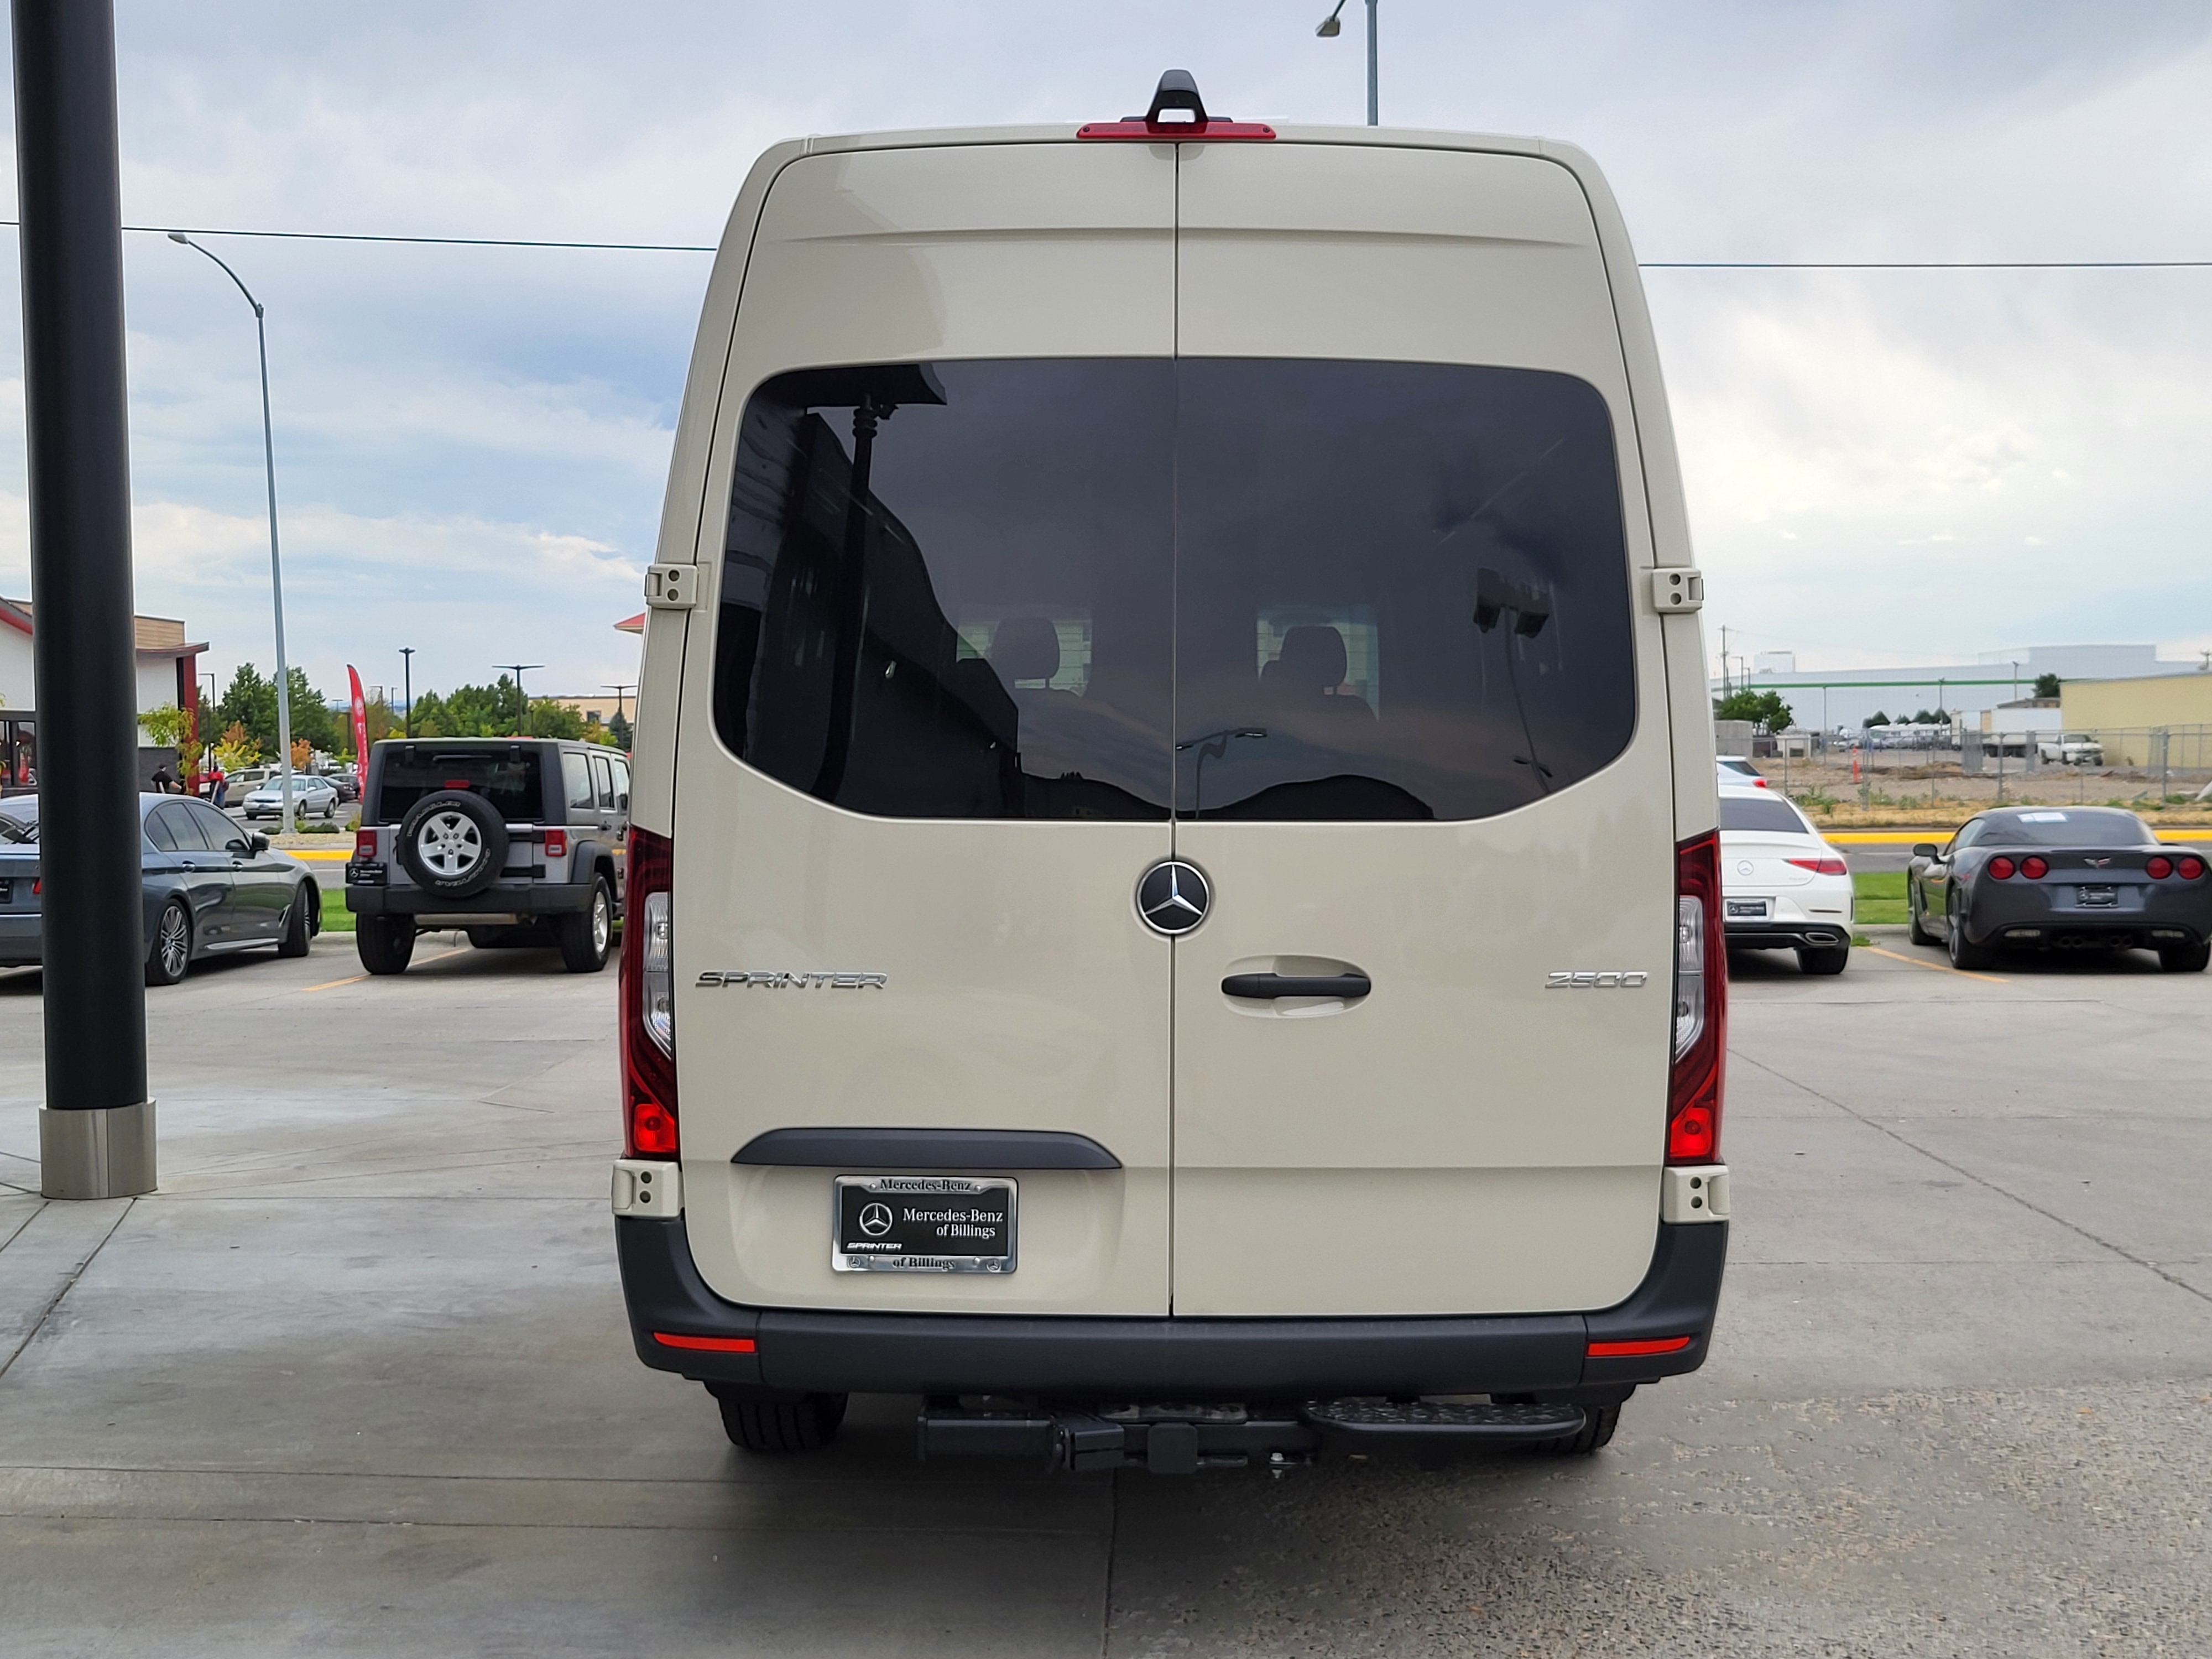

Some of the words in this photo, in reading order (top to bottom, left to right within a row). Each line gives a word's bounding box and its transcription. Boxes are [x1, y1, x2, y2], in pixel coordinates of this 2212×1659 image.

[695, 971, 888, 988] SPRINTER
[1545, 972, 1648, 988] 2500
[880, 1179, 972, 1192] Mercedes-Benz
[902, 1208, 1003, 1222] Mercedes-Benz
[936, 1224, 948, 1237] of
[951, 1224, 996, 1239] Billings
[893, 1258, 907, 1267] of
[909, 1258, 955, 1271] Billings
